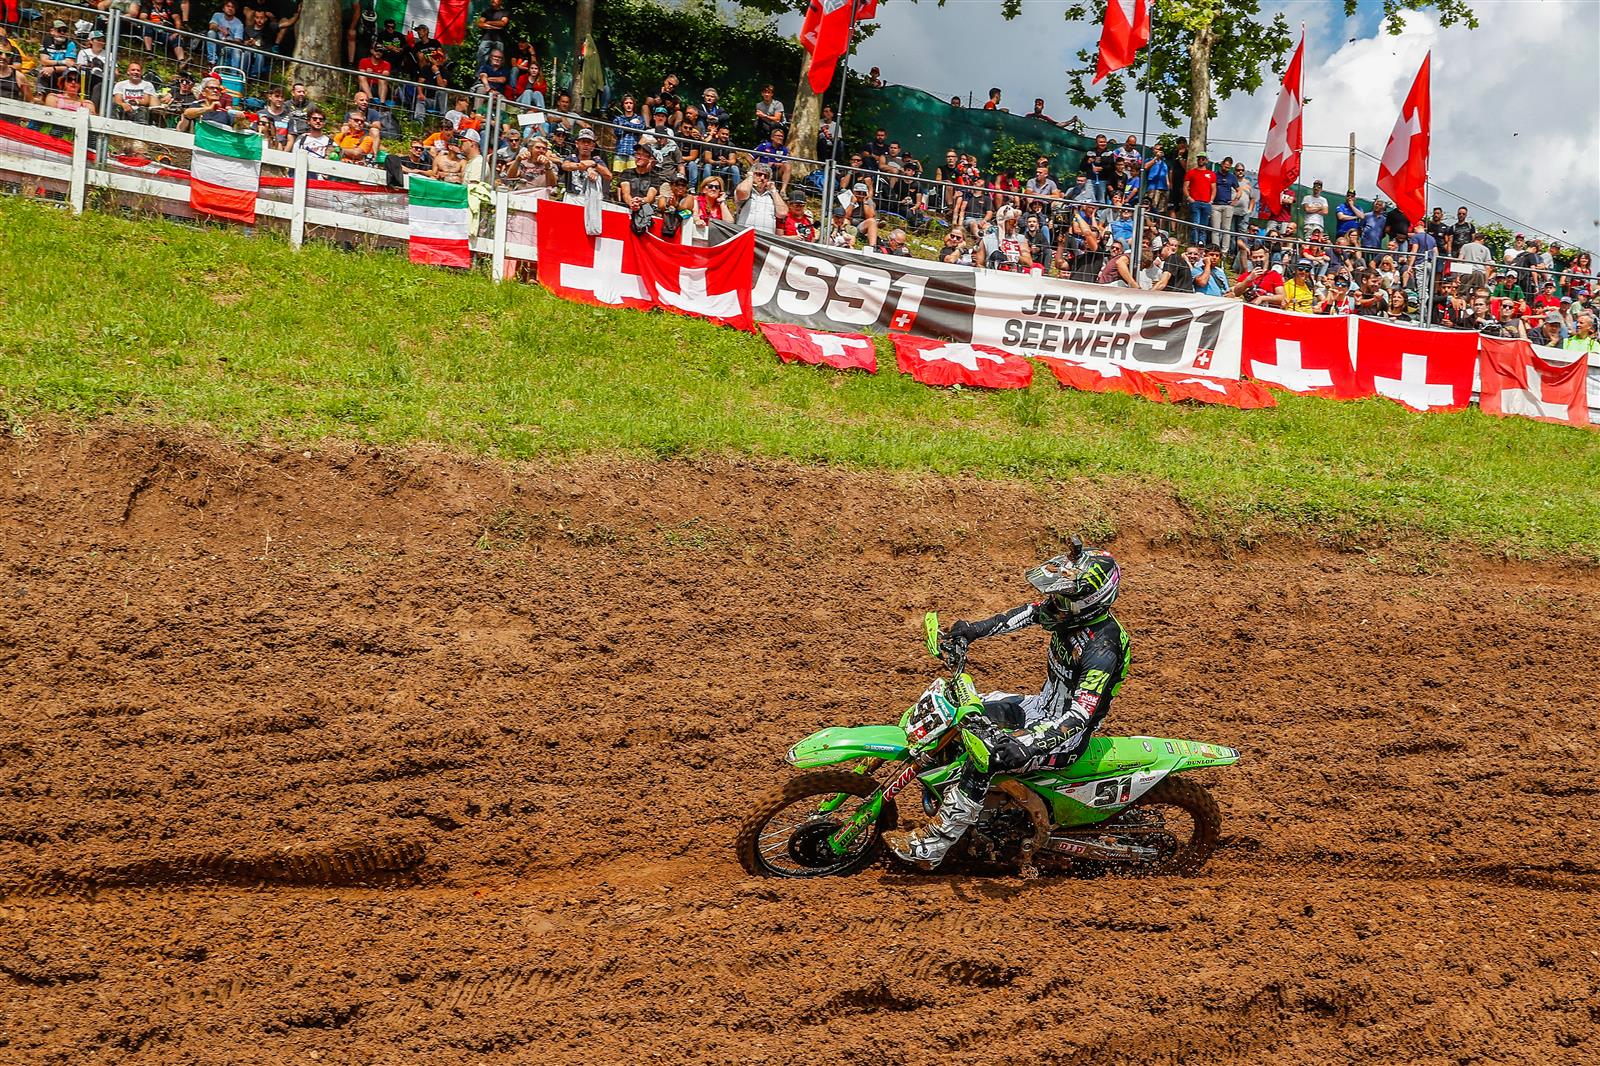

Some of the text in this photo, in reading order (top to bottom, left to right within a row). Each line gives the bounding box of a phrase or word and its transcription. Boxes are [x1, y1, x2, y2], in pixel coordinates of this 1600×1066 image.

[1021, 294, 1141, 327] JEREMY
[1002, 319, 1131, 360] SEEWER
[1132, 306, 1225, 370] 91
